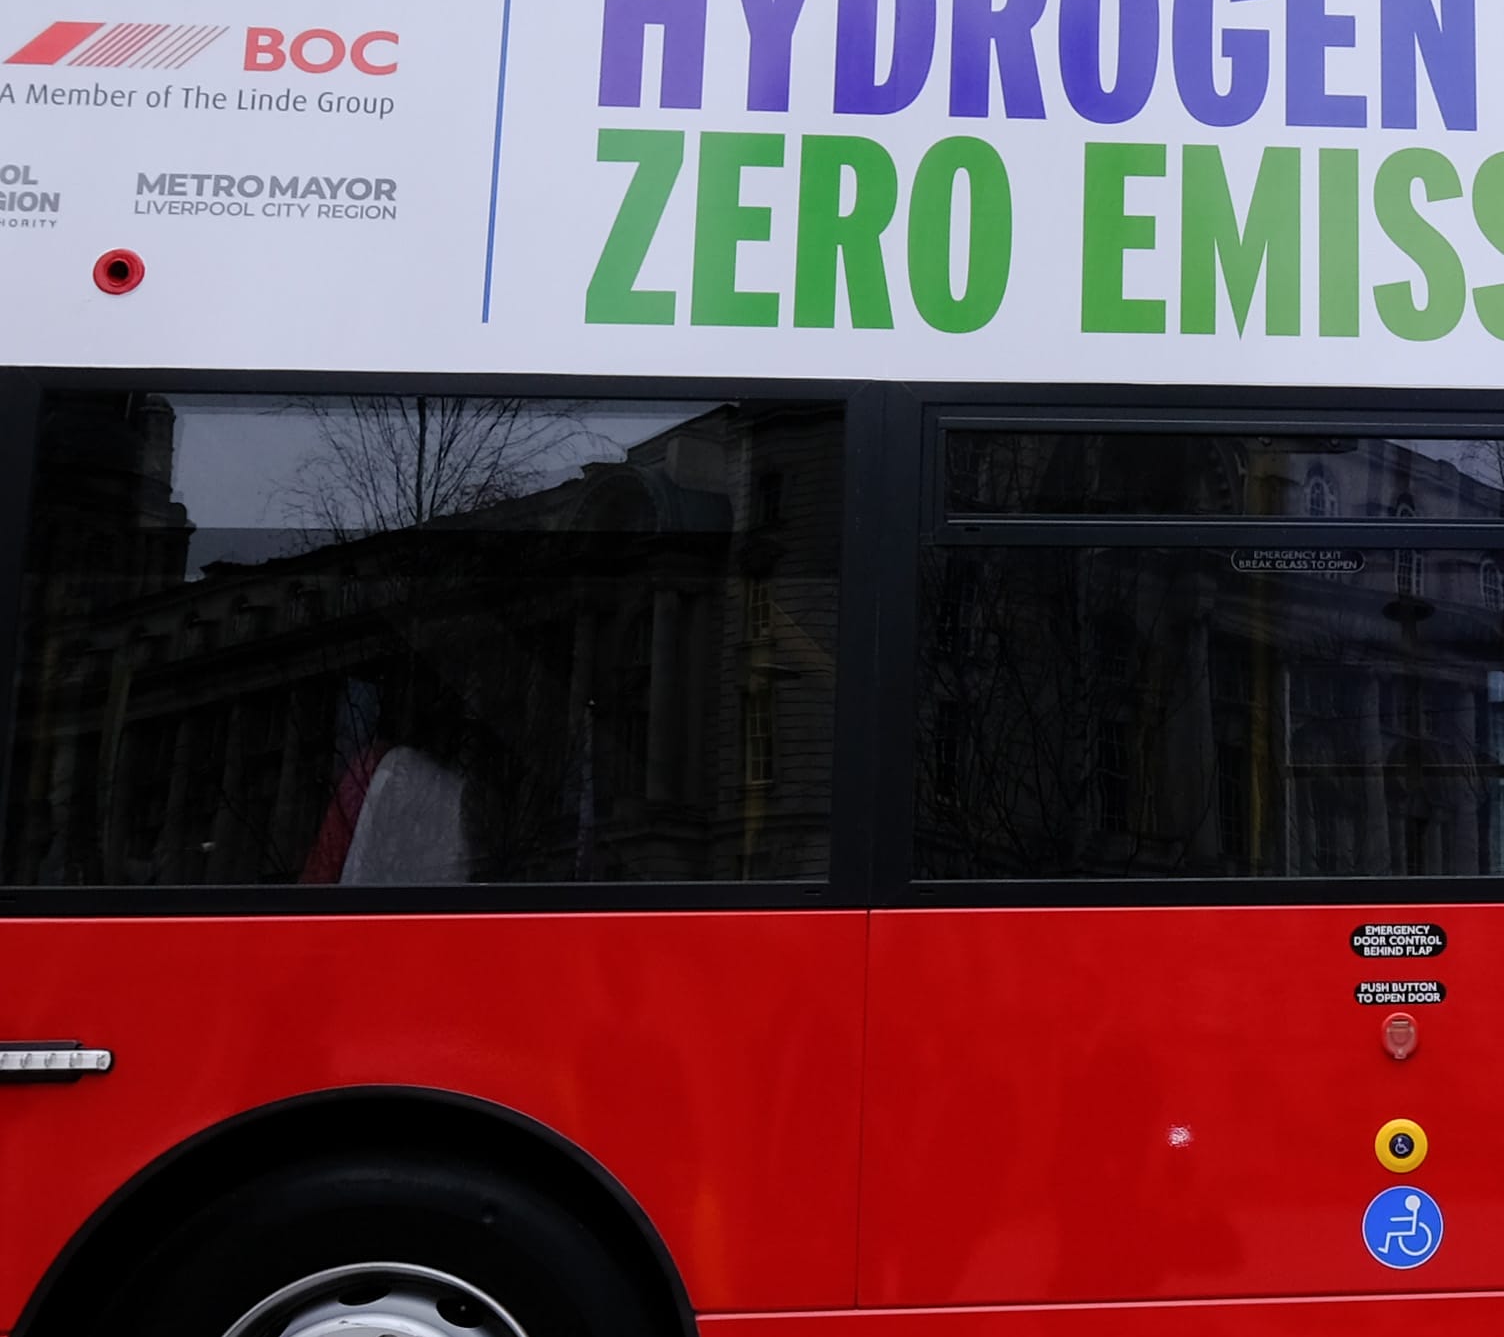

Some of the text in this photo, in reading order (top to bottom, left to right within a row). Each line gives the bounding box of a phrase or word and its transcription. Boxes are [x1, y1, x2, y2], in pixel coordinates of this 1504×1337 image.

[243, 26, 400, 76] BOC
[25, 83, 137, 108] Member
[146, 85, 173, 109] of
[181, 86, 227, 110] The
[237, 88, 307, 112] Linde
[318, 90, 395, 120] Group
[134, 199, 397, 221] LIVERPOOL CITY REGION
[583, 128, 1013, 335] ZERO
[1254, 550, 1341, 560] EMERGENCY EXIT
[1239, 559, 1357, 570] BREAK GLASS TO OPEN
[1364, 925, 1430, 935] EMERGENCY
[1353, 935, 1443, 946] DOOR CONTROL
[1363, 946, 1433, 956] BEHIND FLAP
[1360, 982, 1438, 993] PUSH BUTTON
[1357, 992, 1442, 1003] TO OPEN DOOR
